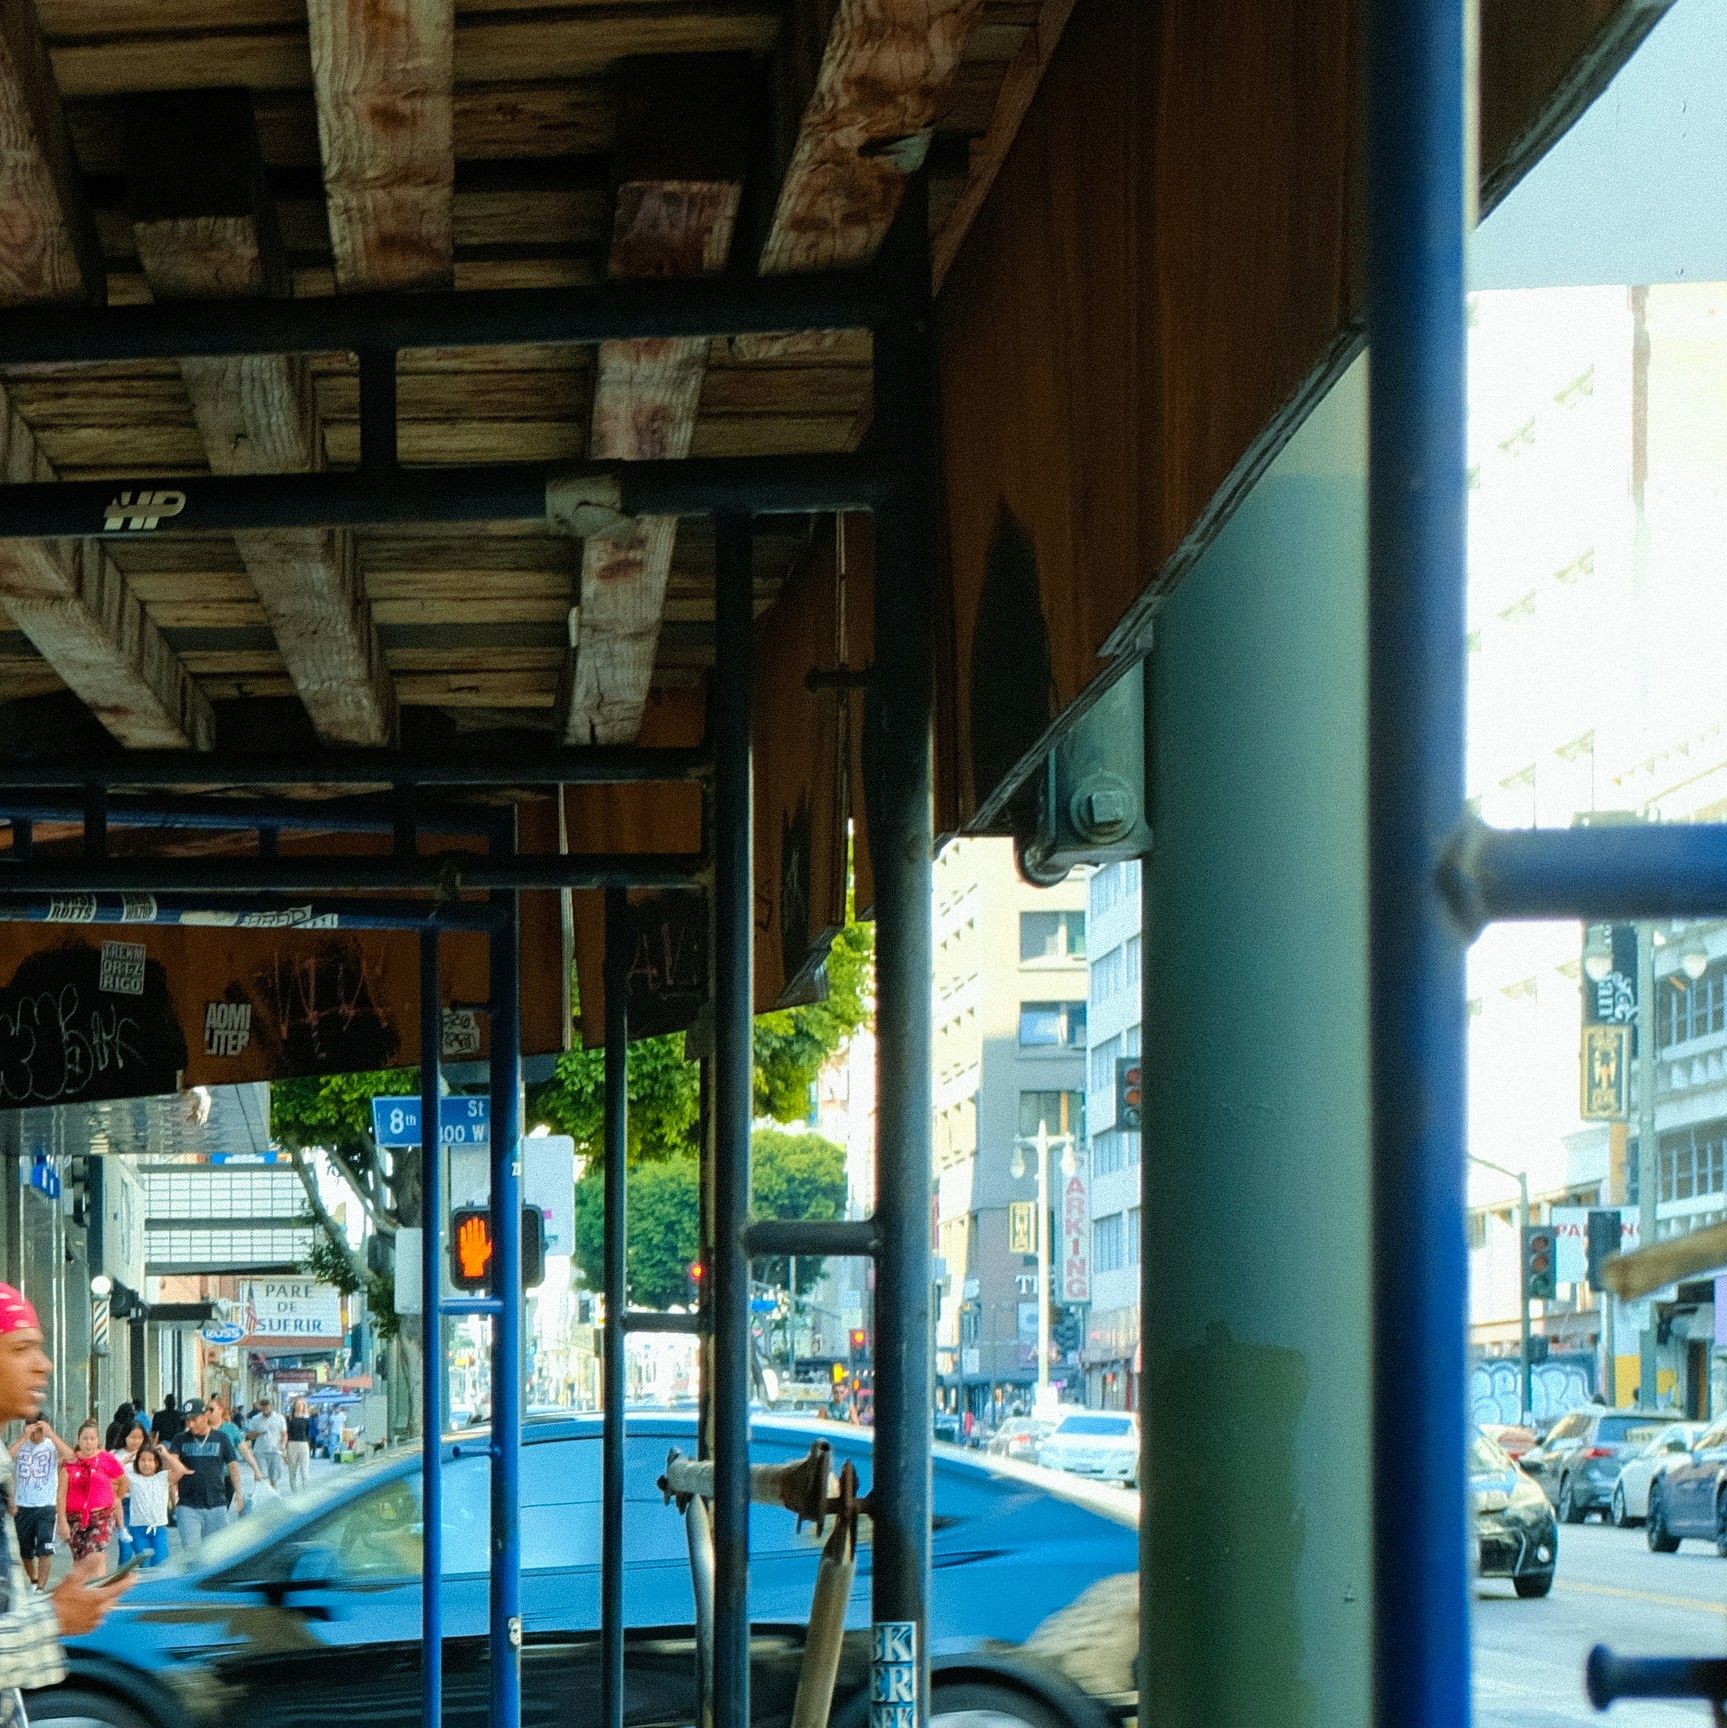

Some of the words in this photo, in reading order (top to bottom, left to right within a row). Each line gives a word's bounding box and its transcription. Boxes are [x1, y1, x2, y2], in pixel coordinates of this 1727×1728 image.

[390, 1107, 417, 1135] 8th
[467, 1099, 485, 1118] St
[439, 1124, 466, 1143] 00
[472, 1124, 485, 1142] W
[1065, 1153, 1088, 1298] ARKING
[265, 1284, 314, 1298] PARE
[278, 1302, 296, 1312] DE
[255, 1317, 323, 1333] SUFRIR
